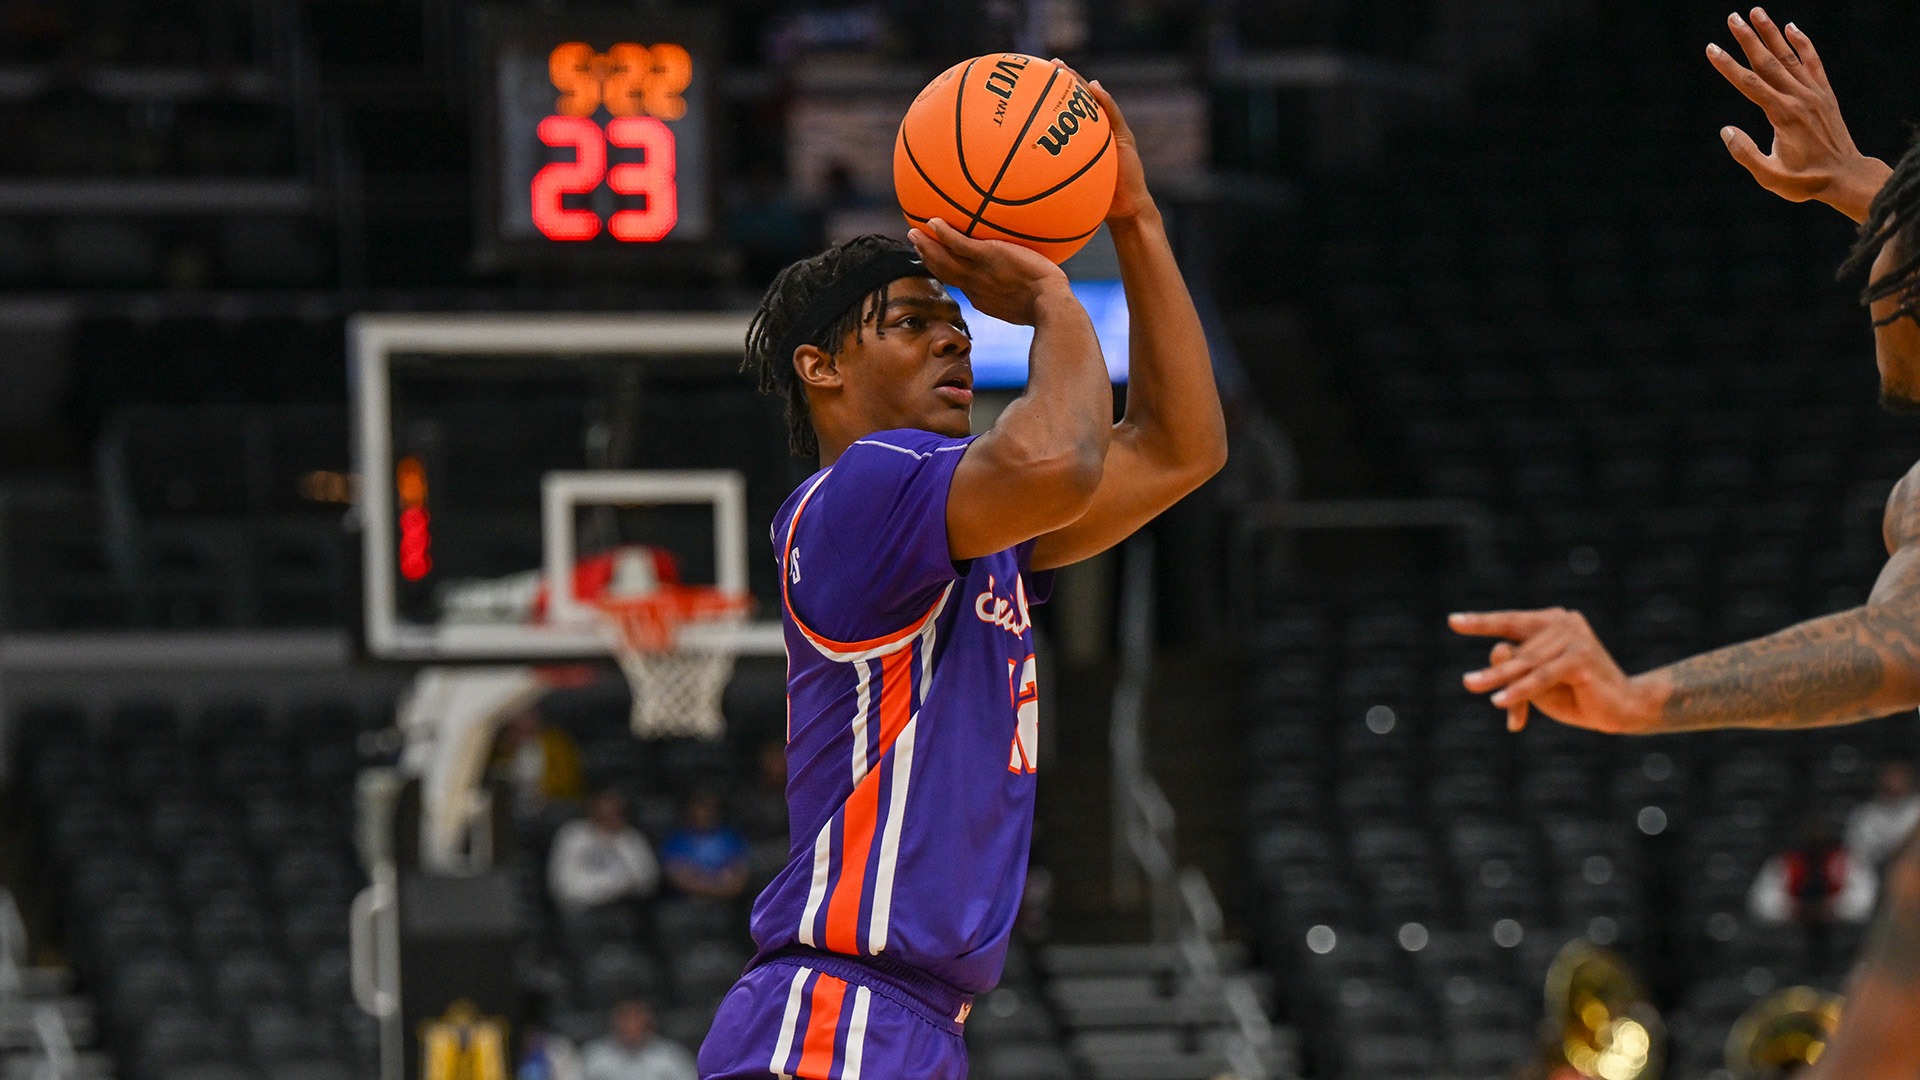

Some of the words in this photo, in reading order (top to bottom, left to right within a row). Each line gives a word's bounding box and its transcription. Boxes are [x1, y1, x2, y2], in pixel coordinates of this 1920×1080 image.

[993, 99, 1008, 127] NXT
[1036, 84, 1099, 157] ilson
[531, 115, 678, 242] 23
